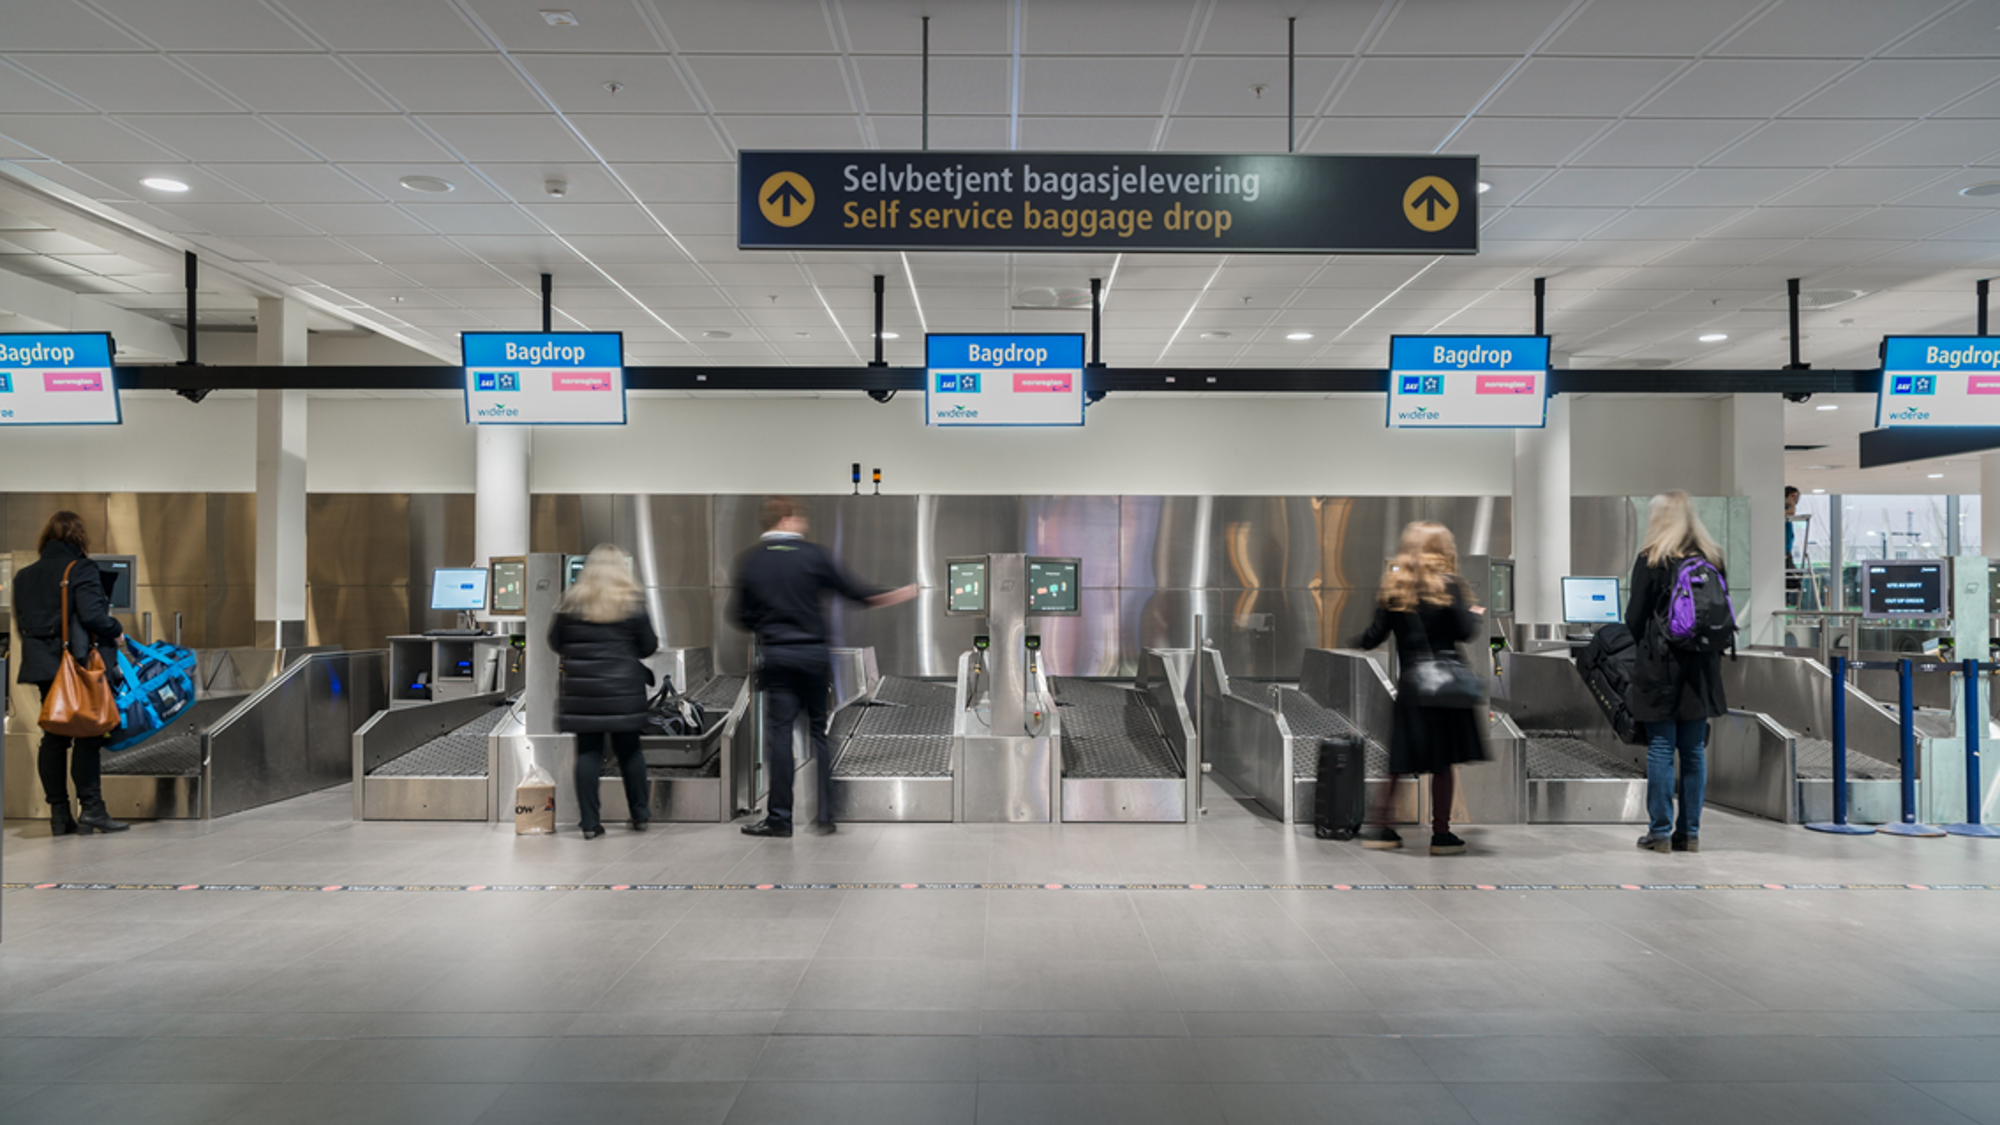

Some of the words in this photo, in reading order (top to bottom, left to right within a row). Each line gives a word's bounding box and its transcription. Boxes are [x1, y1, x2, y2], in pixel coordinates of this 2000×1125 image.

[843, 163, 1013, 200] Selvbetjent
[1023, 164, 1260, 202] bagasjelevering
[843, 200, 900, 229] Self
[909, 201, 1013, 229] service
[1024, 201, 1153, 238] baggage
[1163, 202, 1232, 238] drop
[0, 342, 75, 366] Bagdrop
[505, 341, 585, 365] Bagdrop
[969, 343, 1048, 367] Bagdrop
[1433, 345, 1512, 368] Bagdrop
[1926, 345, 2000, 369] Bagdrop
